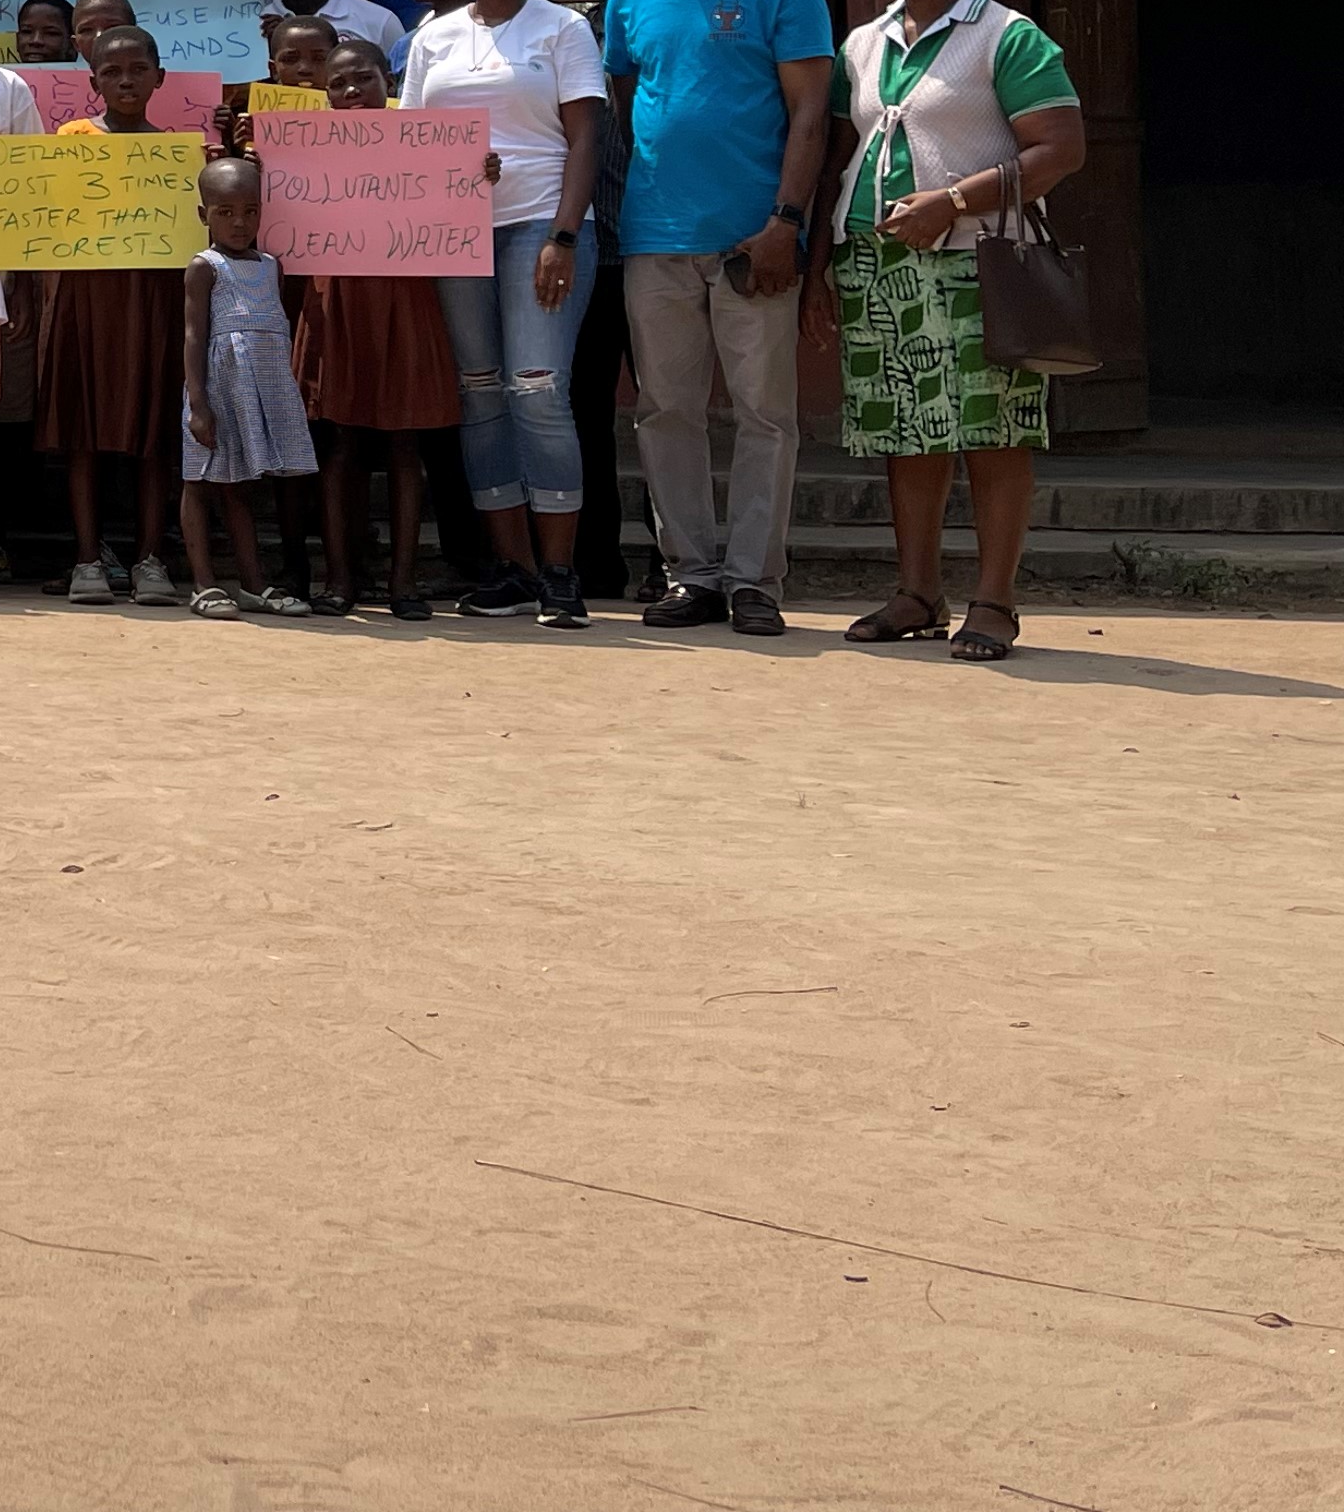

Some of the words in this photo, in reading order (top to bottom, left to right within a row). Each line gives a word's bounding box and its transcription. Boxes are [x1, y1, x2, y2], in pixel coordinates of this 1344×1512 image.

[223, 2, 264, 20] INTO
[261, 118, 385, 147] WETLANDS
[399, 120, 482, 147] REMOVE
[127, 141, 190, 165] ARE
[78, 172, 111, 199] 3
[119, 172, 196, 193] TIMES
[266, 169, 429, 204] POLLUTANTS
[445, 168, 490, 200] FOR
[97, 204, 178, 228] THAN
[22, 233, 174, 262] FORESTS
[263, 220, 366, 259] CLEAN
[387, 219, 482, 261] WATER
